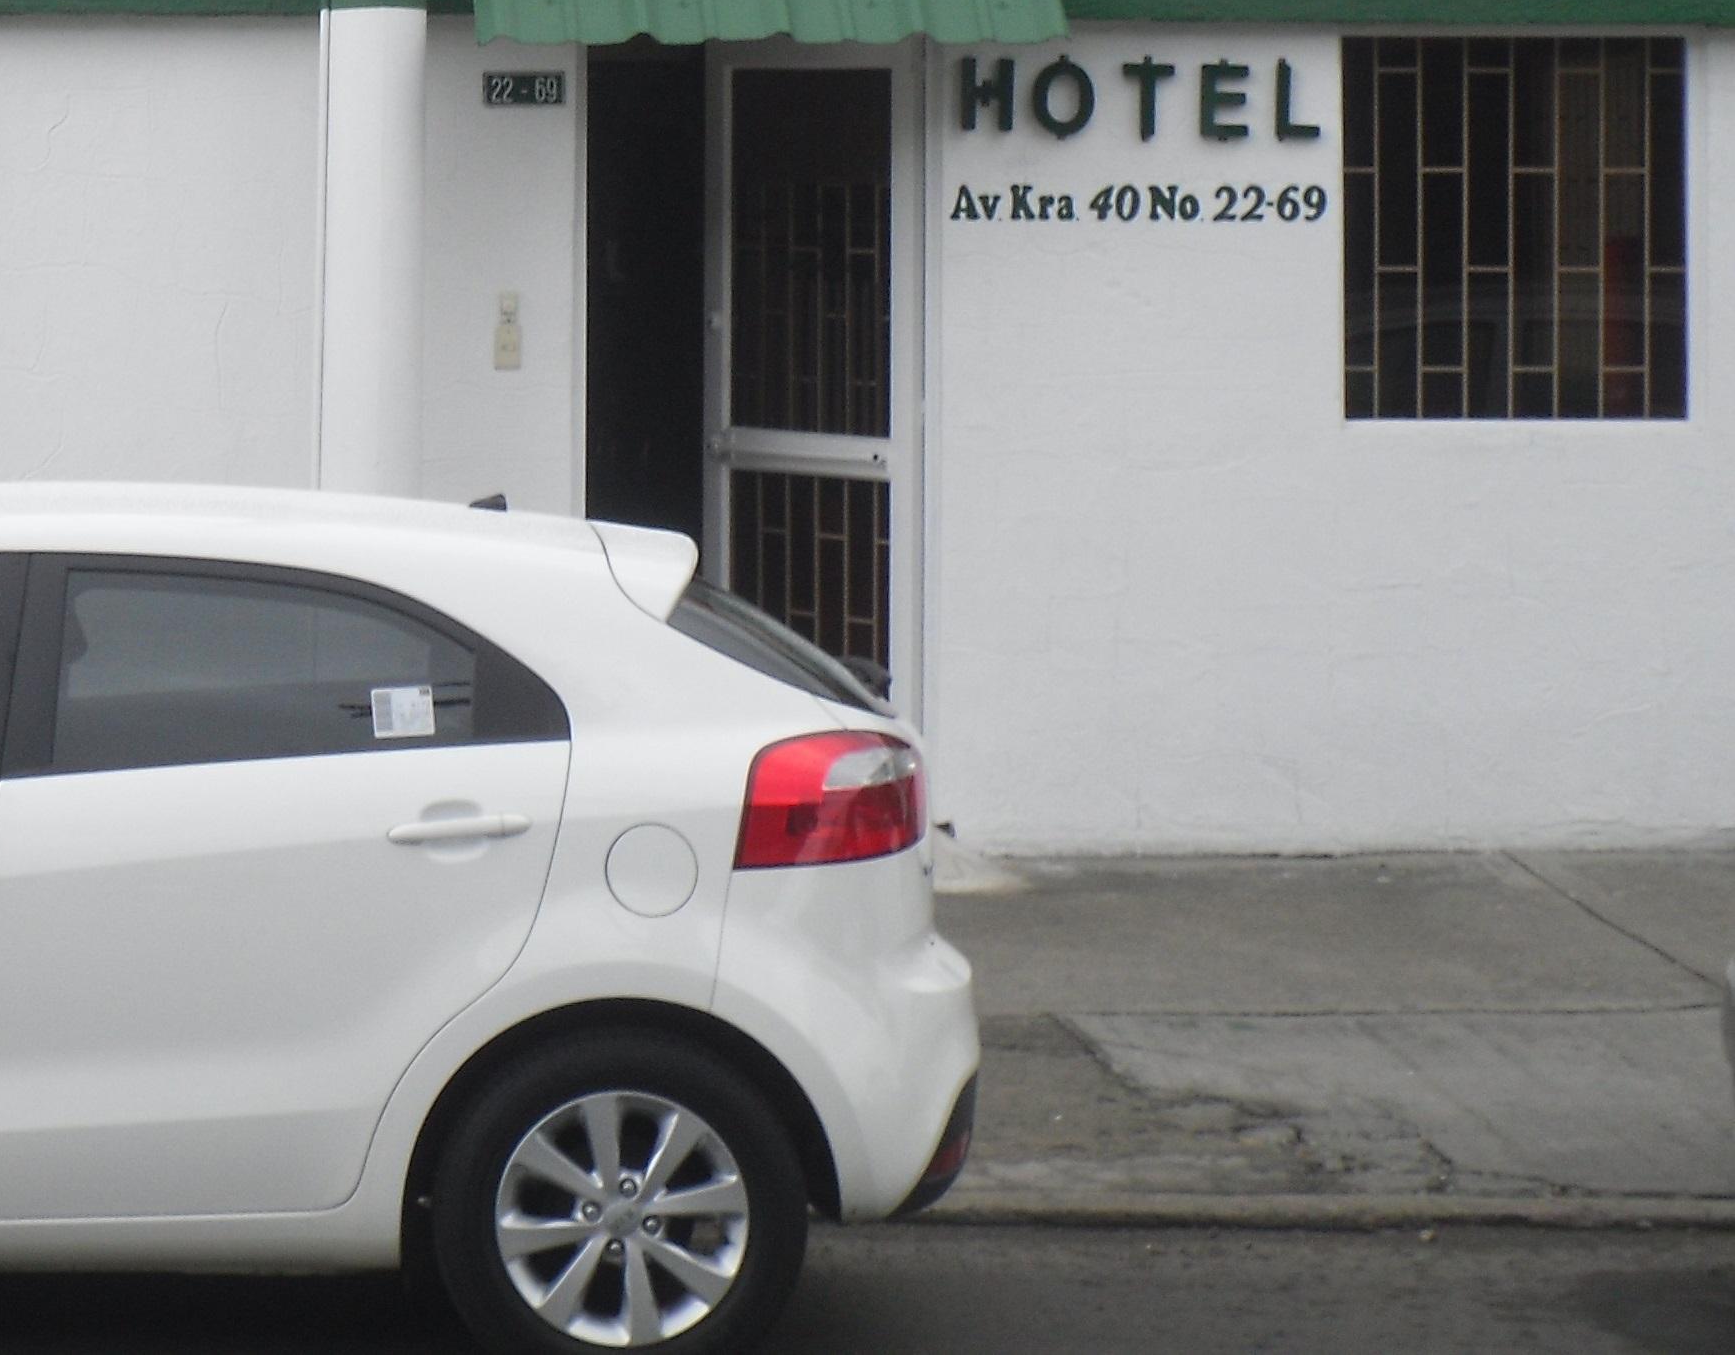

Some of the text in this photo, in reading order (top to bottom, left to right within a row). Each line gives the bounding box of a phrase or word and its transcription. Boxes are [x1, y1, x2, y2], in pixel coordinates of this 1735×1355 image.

[960, 53, 1322, 142] HOTEL
[1088, 183, 1141, 222] 40
[1211, 184, 1328, 223] 22-69
